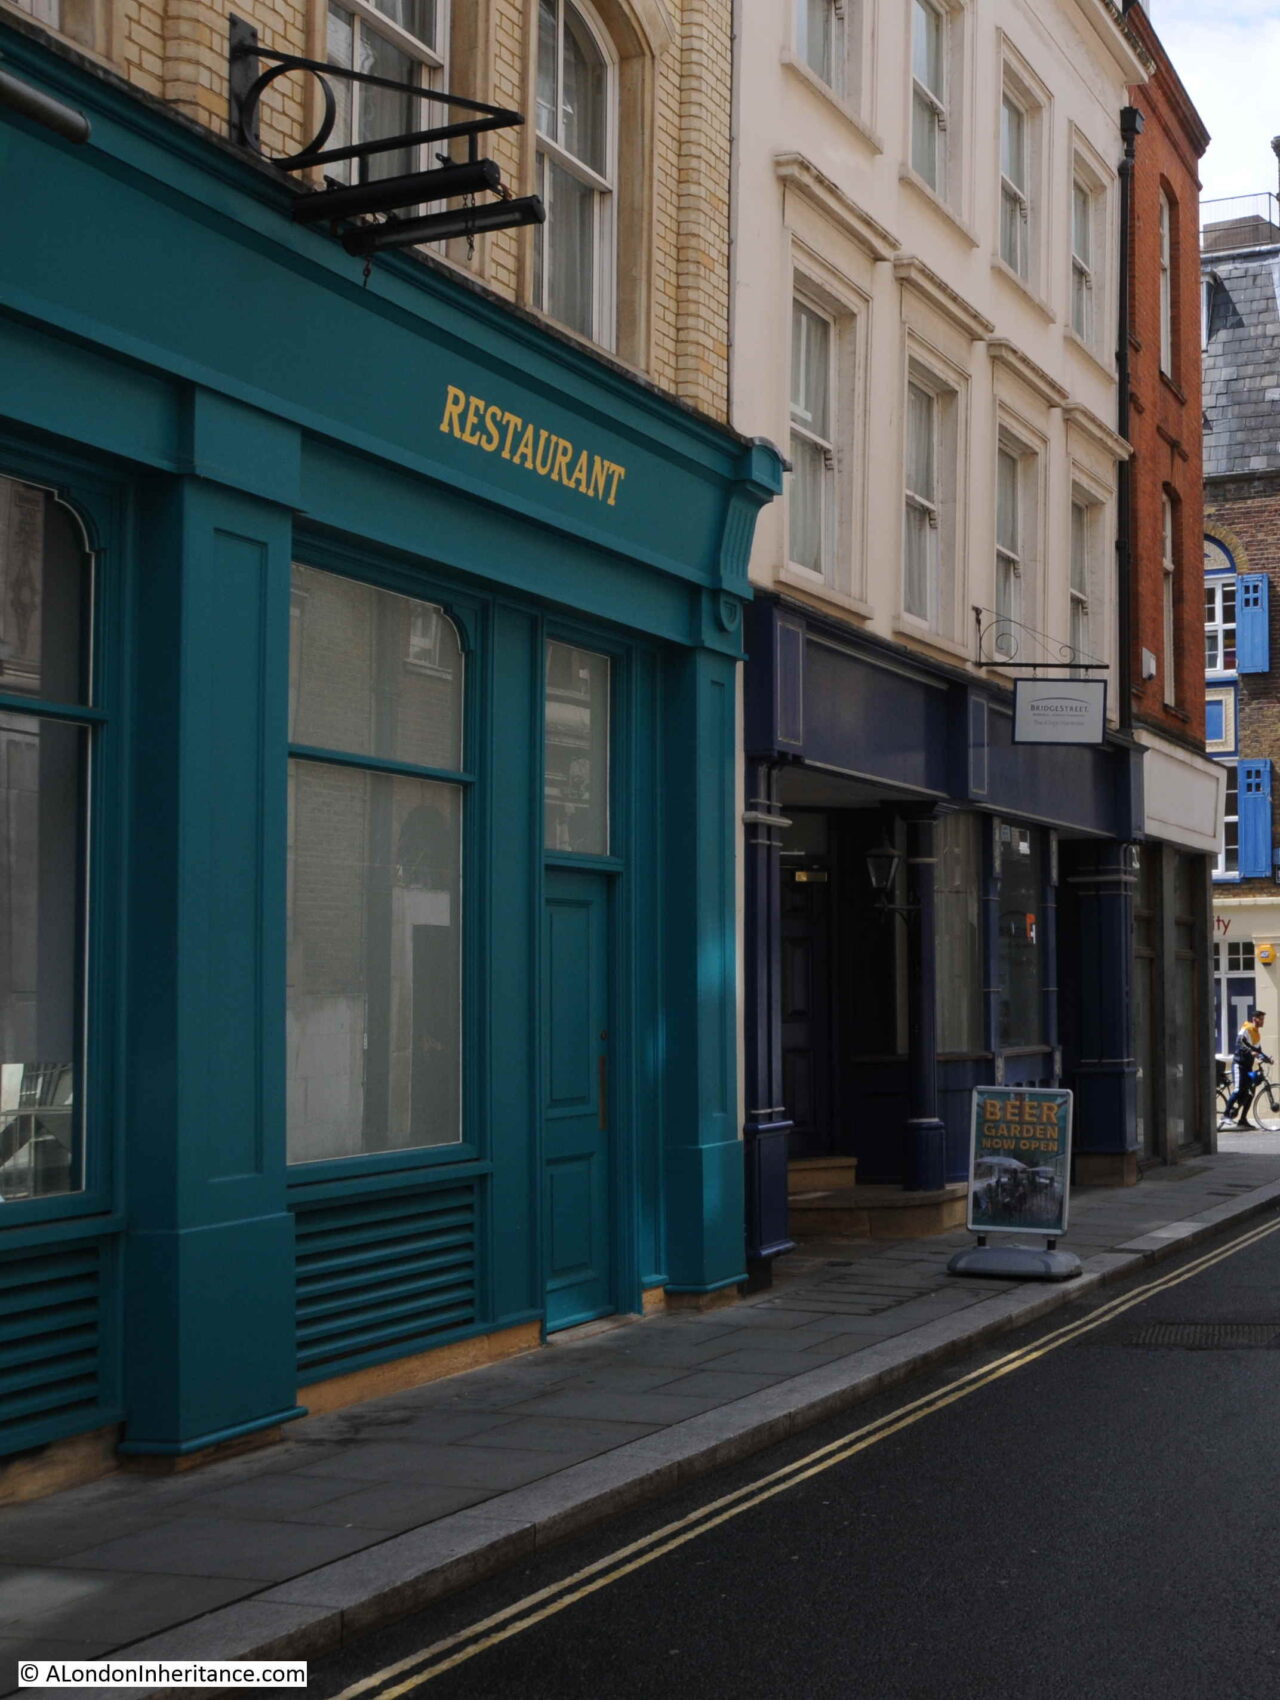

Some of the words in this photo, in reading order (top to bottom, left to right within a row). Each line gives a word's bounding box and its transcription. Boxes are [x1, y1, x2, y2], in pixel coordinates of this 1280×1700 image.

[440, 384, 626, 506] RESTAURANT
[985, 1099, 1058, 1123] BEER
[984, 1123, 1058, 1138] GARDEN
[982, 1138, 1016, 1150] NOW
[1019, 1140, 1058, 1152] OPEN
